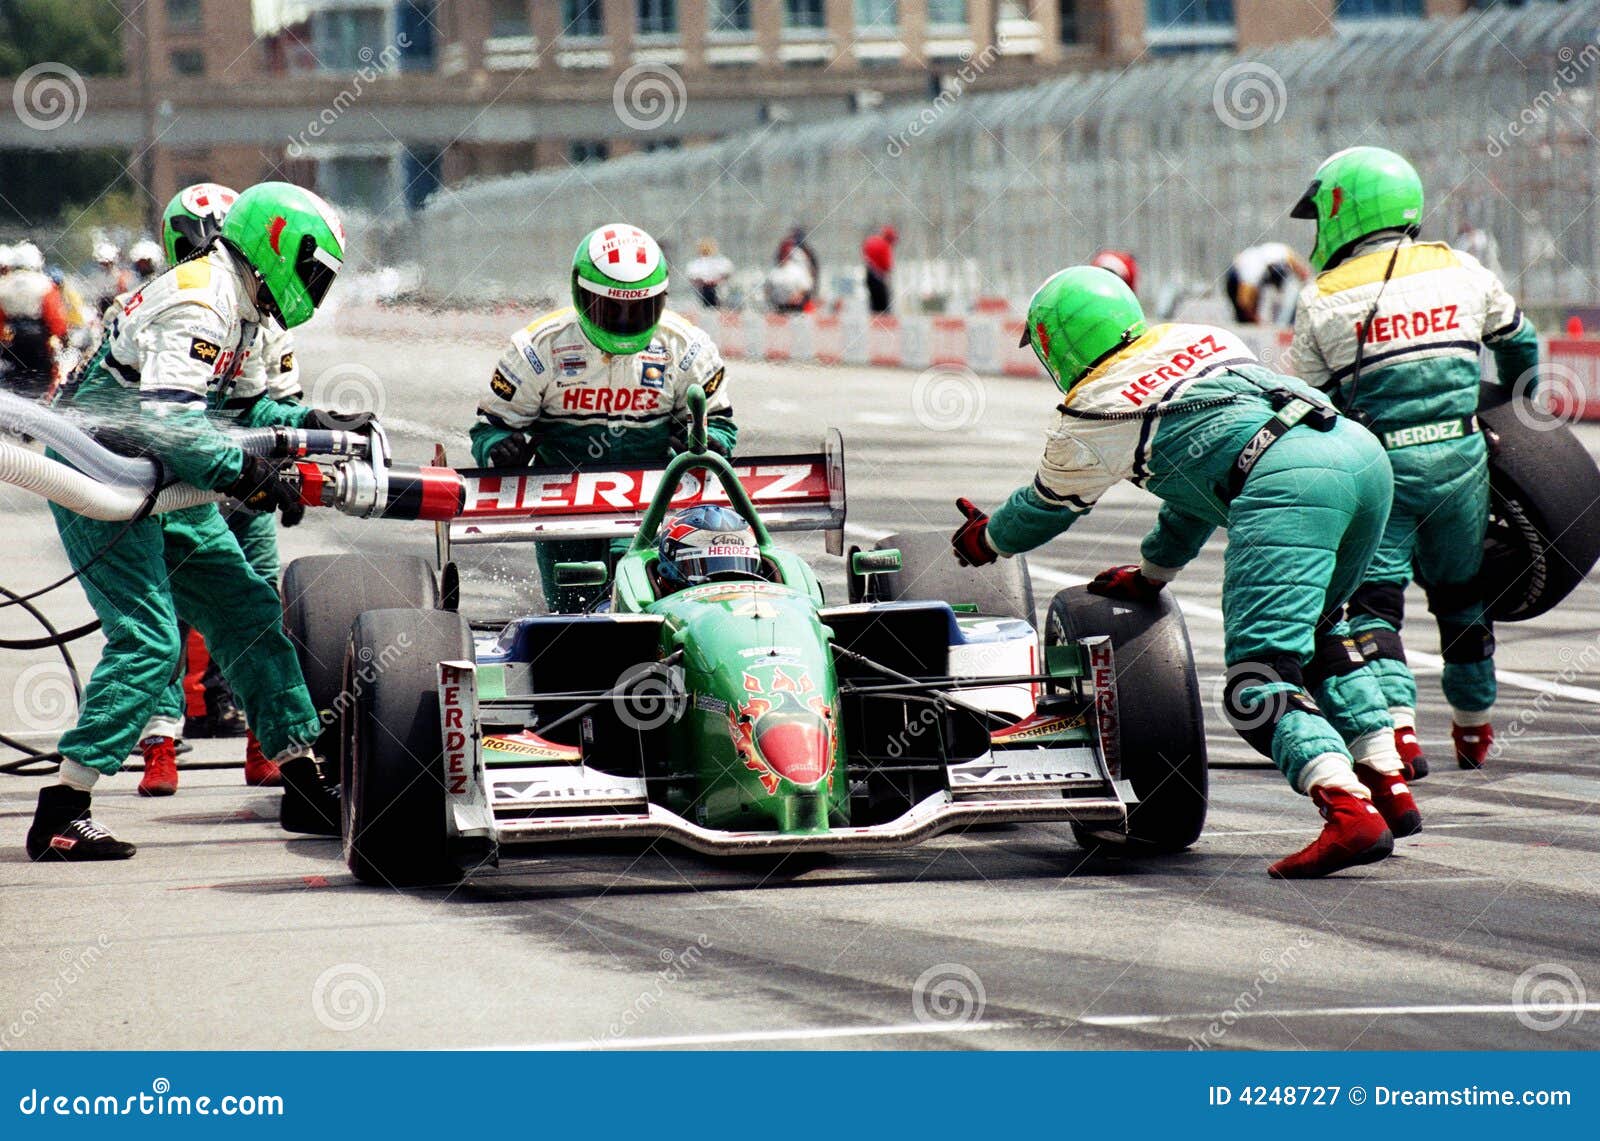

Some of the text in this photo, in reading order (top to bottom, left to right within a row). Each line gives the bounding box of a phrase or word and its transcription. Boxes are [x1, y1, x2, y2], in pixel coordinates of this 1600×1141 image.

[608, 288, 650, 298] HERDEZ
[1356, 304, 1459, 343] HERDEZ
[1121, 334, 1227, 406] HERDEZ
[563, 387, 661, 413] HERDEZ
[1385, 420, 1462, 449] HERDEZ
[464, 464, 813, 511] HERDEZ
[708, 546, 751, 556] HERDEZ
[441, 667, 468, 795] HERDEZ
